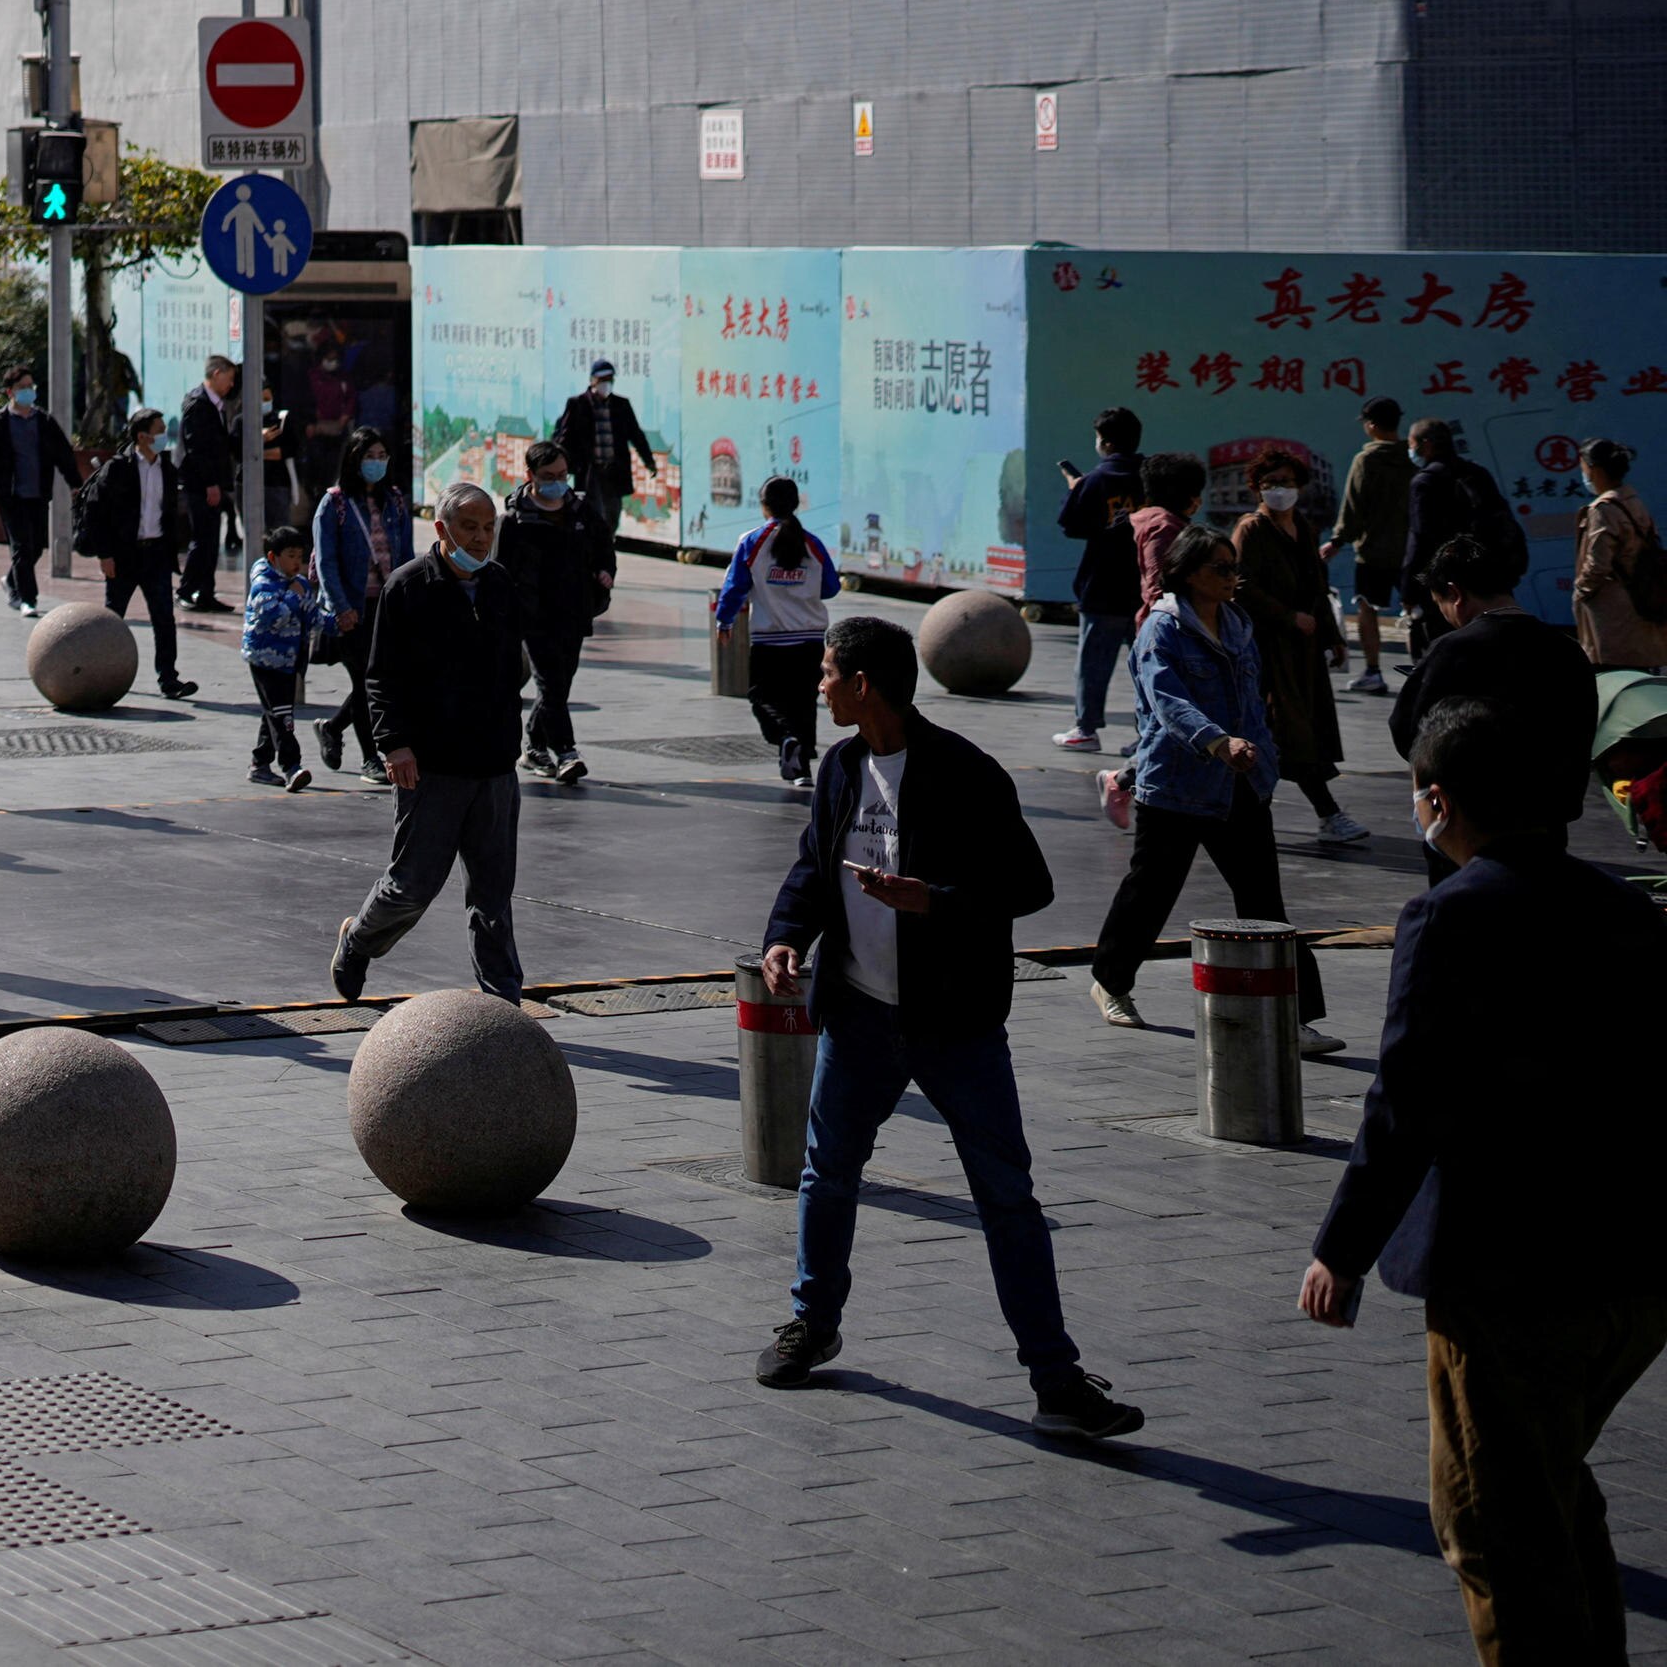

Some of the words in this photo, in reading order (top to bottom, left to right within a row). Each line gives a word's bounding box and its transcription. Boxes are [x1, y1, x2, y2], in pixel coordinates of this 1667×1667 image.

[212, 139, 301, 160] 除特种车辆外
[720, 293, 791, 343] 真老大房
[1255, 266, 1535, 333] 真老大房
[695, 367, 751, 399] 装修期间
[759, 372, 821, 405] 正常营业
[920, 339, 992, 417] 志愿者
[1135, 350, 1367, 396] 装修期间
[1422, 356, 1667, 402] 正常营业
[1512, 475, 1593, 498] 真老大
